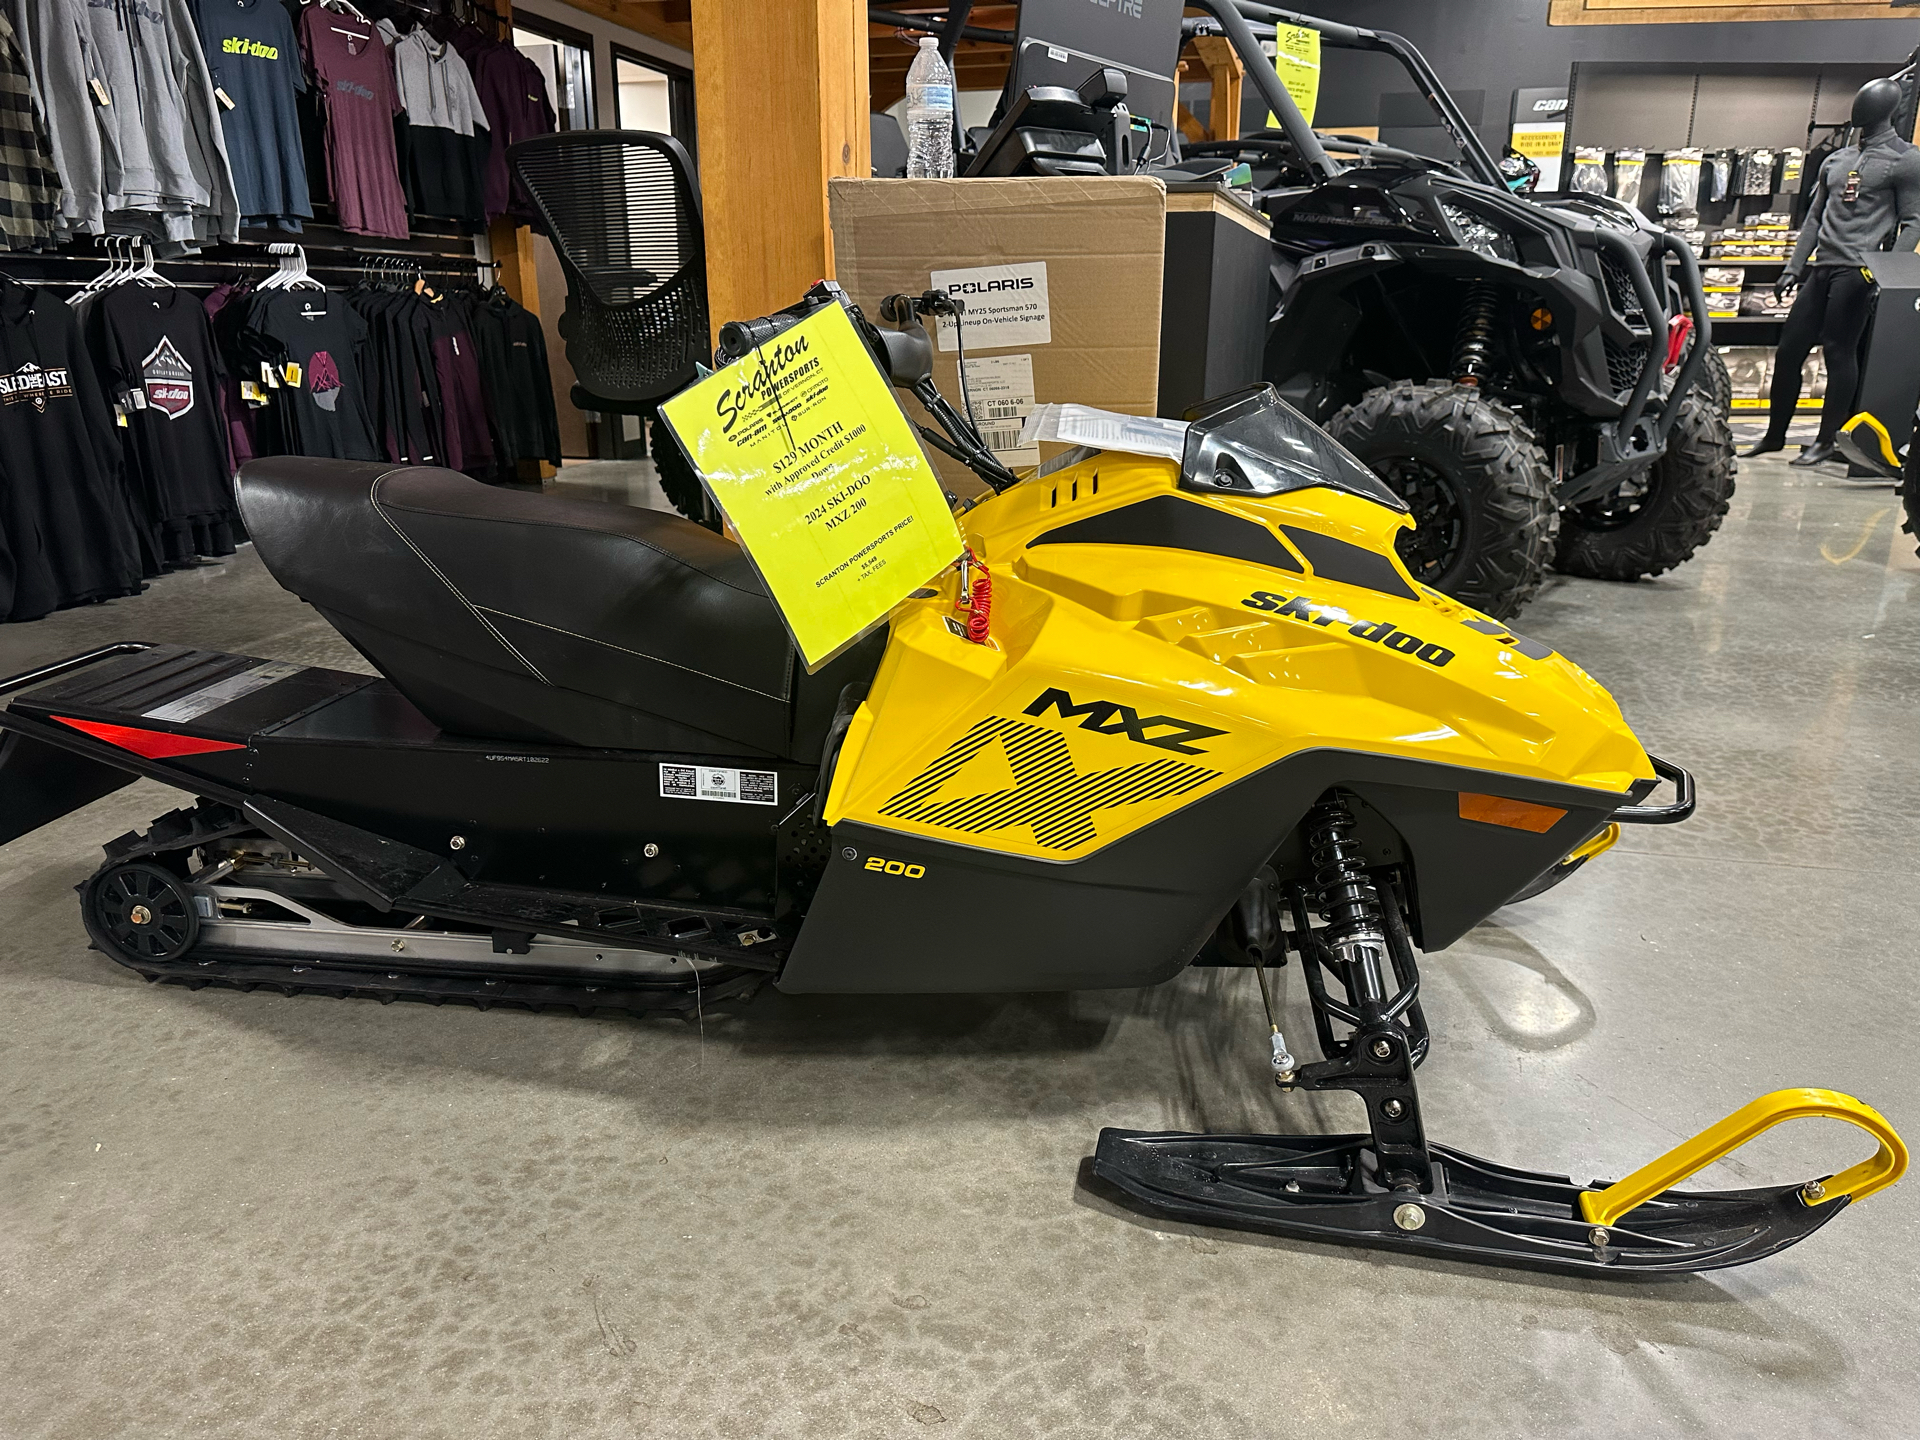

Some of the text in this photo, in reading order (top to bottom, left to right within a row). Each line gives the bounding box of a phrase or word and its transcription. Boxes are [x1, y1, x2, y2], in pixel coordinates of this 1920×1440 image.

[222, 37, 279, 60] ski-doo
[336, 80, 374, 100] ski-doo
[948, 277, 1034, 295] POLARIS
[968, 308, 987, 316] MY25
[988, 304, 1024, 314] Sportsman
[982, 315, 1018, 325] On-Vehicle
[1019, 313, 1046, 323] Signage
[716, 335, 809, 434] Scranton
[761, 357, 820, 401] POWERSPORTS
[736, 424, 768, 447] can-am
[738, 417, 764, 436] POLARIS
[765, 424, 867, 496] with Approved Credit $1000
[772, 420, 844, 474] $129 MONTH
[810, 463, 834, 479] Down
[804, 474, 871, 525] 2024 SKI-DOO
[825, 497, 867, 532] MXZ 200
[815, 515, 914, 588] SCRANTON POWERSPORTS PRICE!
[1240, 589, 1456, 669] ski-doo
[1021, 686, 1232, 756] MXZ
[864, 856, 926, 879] 200
